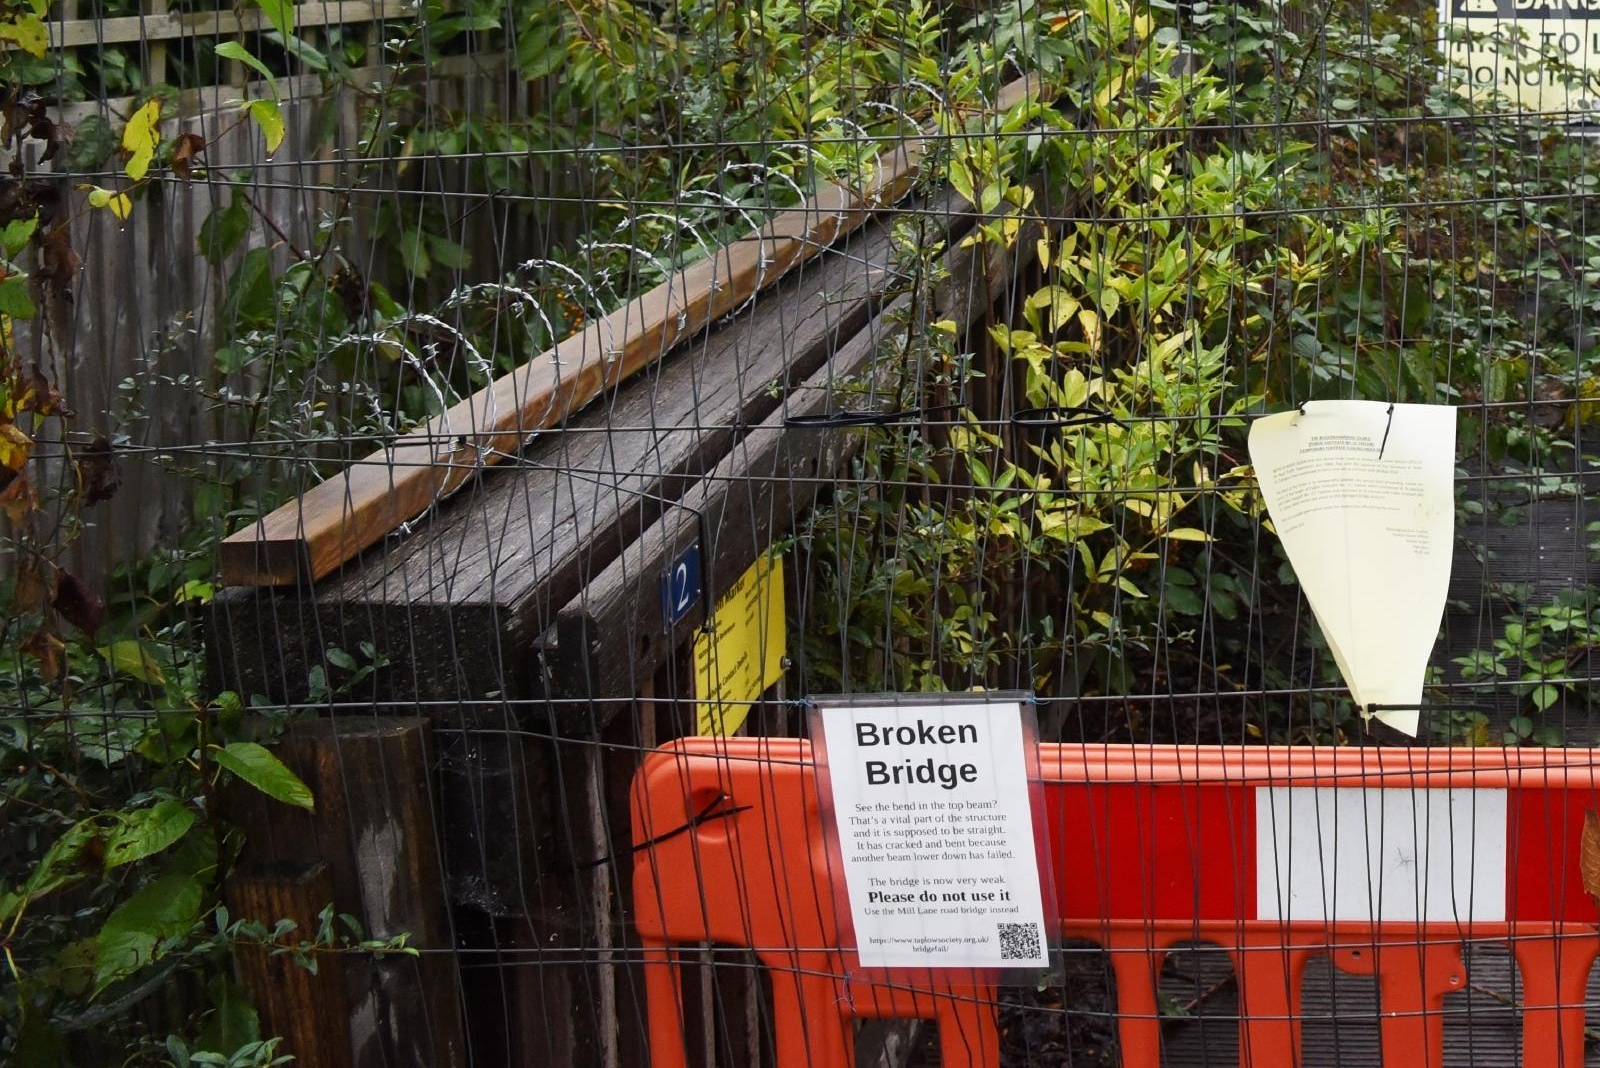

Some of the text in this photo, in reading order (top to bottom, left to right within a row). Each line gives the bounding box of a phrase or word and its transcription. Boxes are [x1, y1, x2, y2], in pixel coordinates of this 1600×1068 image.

[1540, 32, 1580, 54] TO
[676, 563, 689, 612] 2
[856, 719, 978, 747] Broken
[866, 758, 978, 790] Bridge
[856, 804, 872, 812] See
[919, 802, 927, 810] in
[931, 802, 945, 810] the
[948, 803, 963, 812] top
[967, 800, 997, 809] beam?
[849, 817, 878, 825] That's
[914, 816, 931, 825] part
[935, 815, 944, 823] of
[854, 829, 870, 837] and
[874, 829, 879, 837] it
[883, 829, 891, 837] is
[894, 828, 937, 838] supposed
[953, 826, 964, 835] be
[967, 826, 1006, 836] straight.
[858, 842, 864, 850] It
[867, 842, 882, 850] has
[886, 841, 922, 849] cracked
[945, 840, 965, 848] bent
[887, 853, 910, 861] beam
[914, 853, 938, 861] lower
[942, 852, 966, 860] down
[969, 851, 984, 859] has
[988, 850, 1015, 859] failed.
[869, 877, 887, 886] The
[890, 877, 919, 887] bridge
[957, 877, 977, 885] very
[868, 890, 1010, 903] Please do not use it
[882, 907, 895, 915] the
[940, 906, 958, 914] road
[961, 906, 987, 914] bridge
